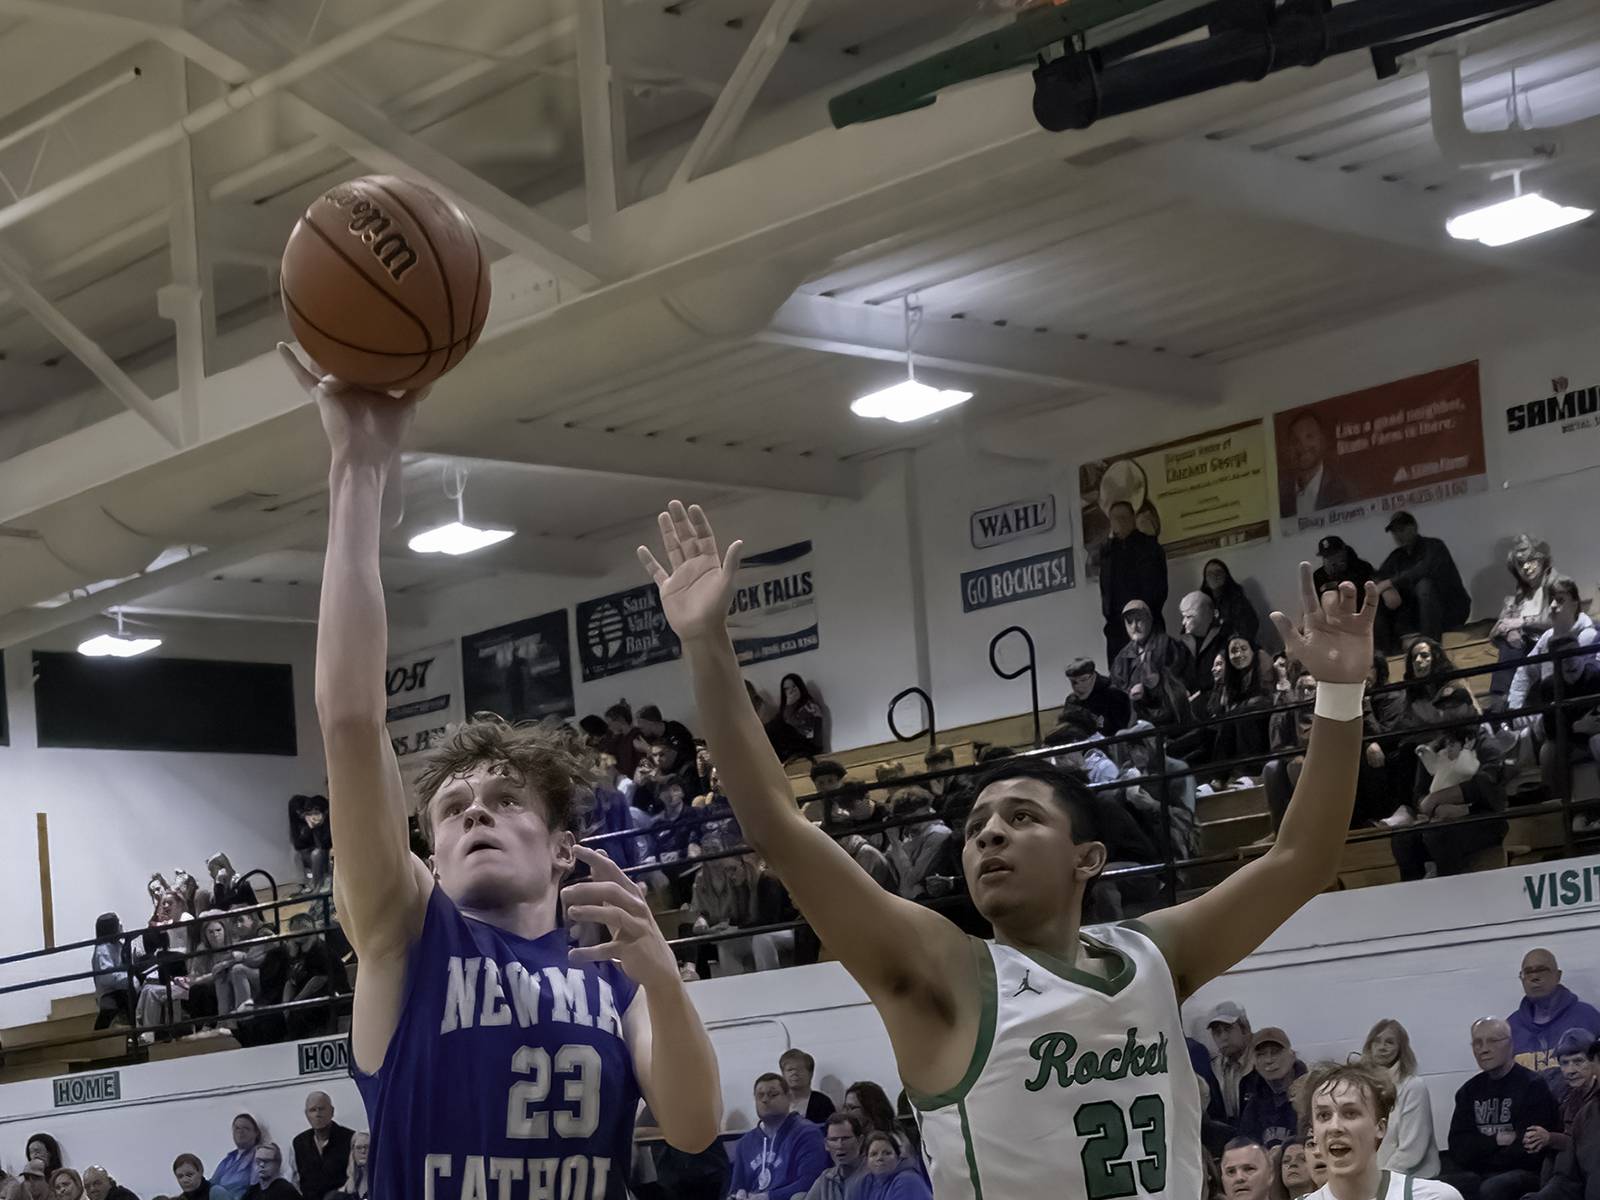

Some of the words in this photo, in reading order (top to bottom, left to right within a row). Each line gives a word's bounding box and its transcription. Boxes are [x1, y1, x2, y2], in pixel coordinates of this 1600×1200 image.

[1507, 385, 1600, 433] SAMU
[979, 502, 1048, 539] WAHL
[763, 571, 814, 606] FALLS
[967, 576, 988, 606] GO
[991, 556, 1068, 600] ROCKETS!
[1025, 1027, 1168, 1092] Rocket
[57, 1075, 116, 1104] HOME
[505, 1043, 602, 1139] 23
